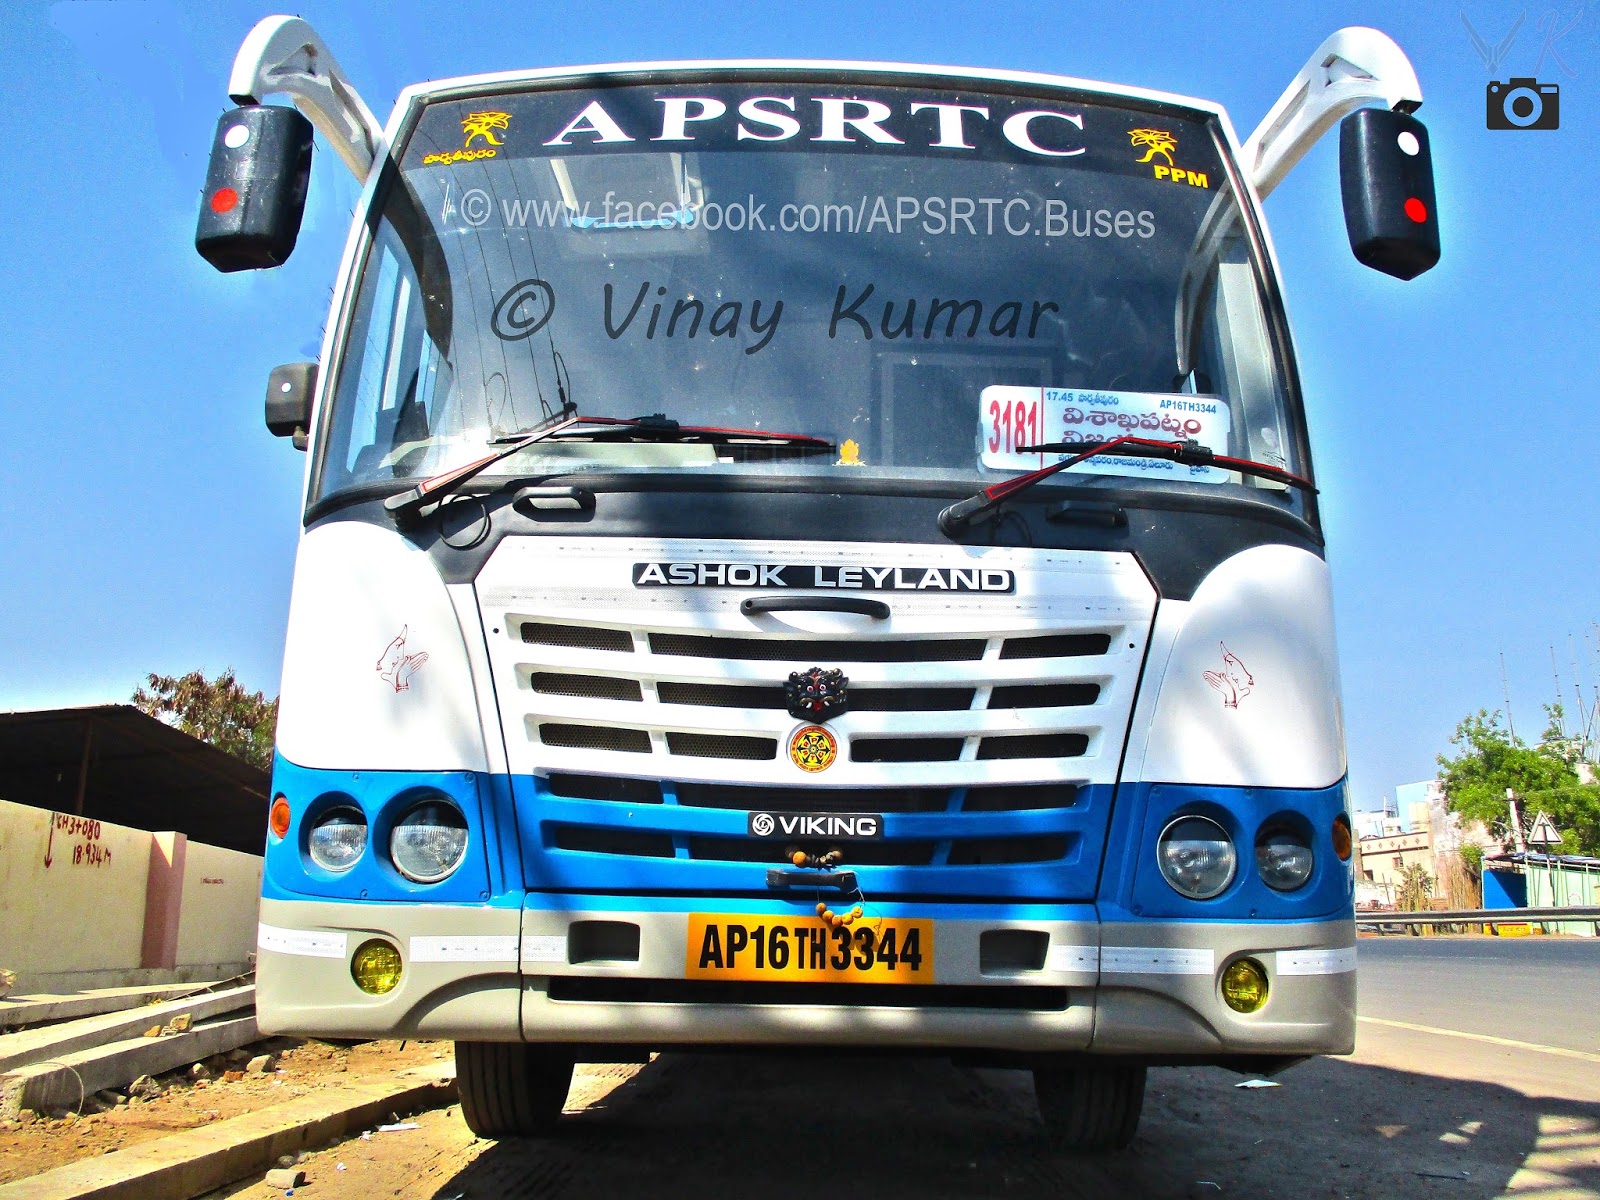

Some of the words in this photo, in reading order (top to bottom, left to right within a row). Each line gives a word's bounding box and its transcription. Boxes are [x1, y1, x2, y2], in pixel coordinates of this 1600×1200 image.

[542, 97, 1086, 157] APSRTC
[1153, 165, 1209, 189] PPM
[1046, 391, 1074, 402] 17.45
[1159, 399, 1217, 415] AP16TH3344
[989, 400, 1037, 455] 3181
[637, 563, 788, 586] ASHOK
[814, 566, 1011, 592] LEYLAND
[779, 816, 877, 836] VIKING
[699, 924, 922, 971] AP16TH3344
